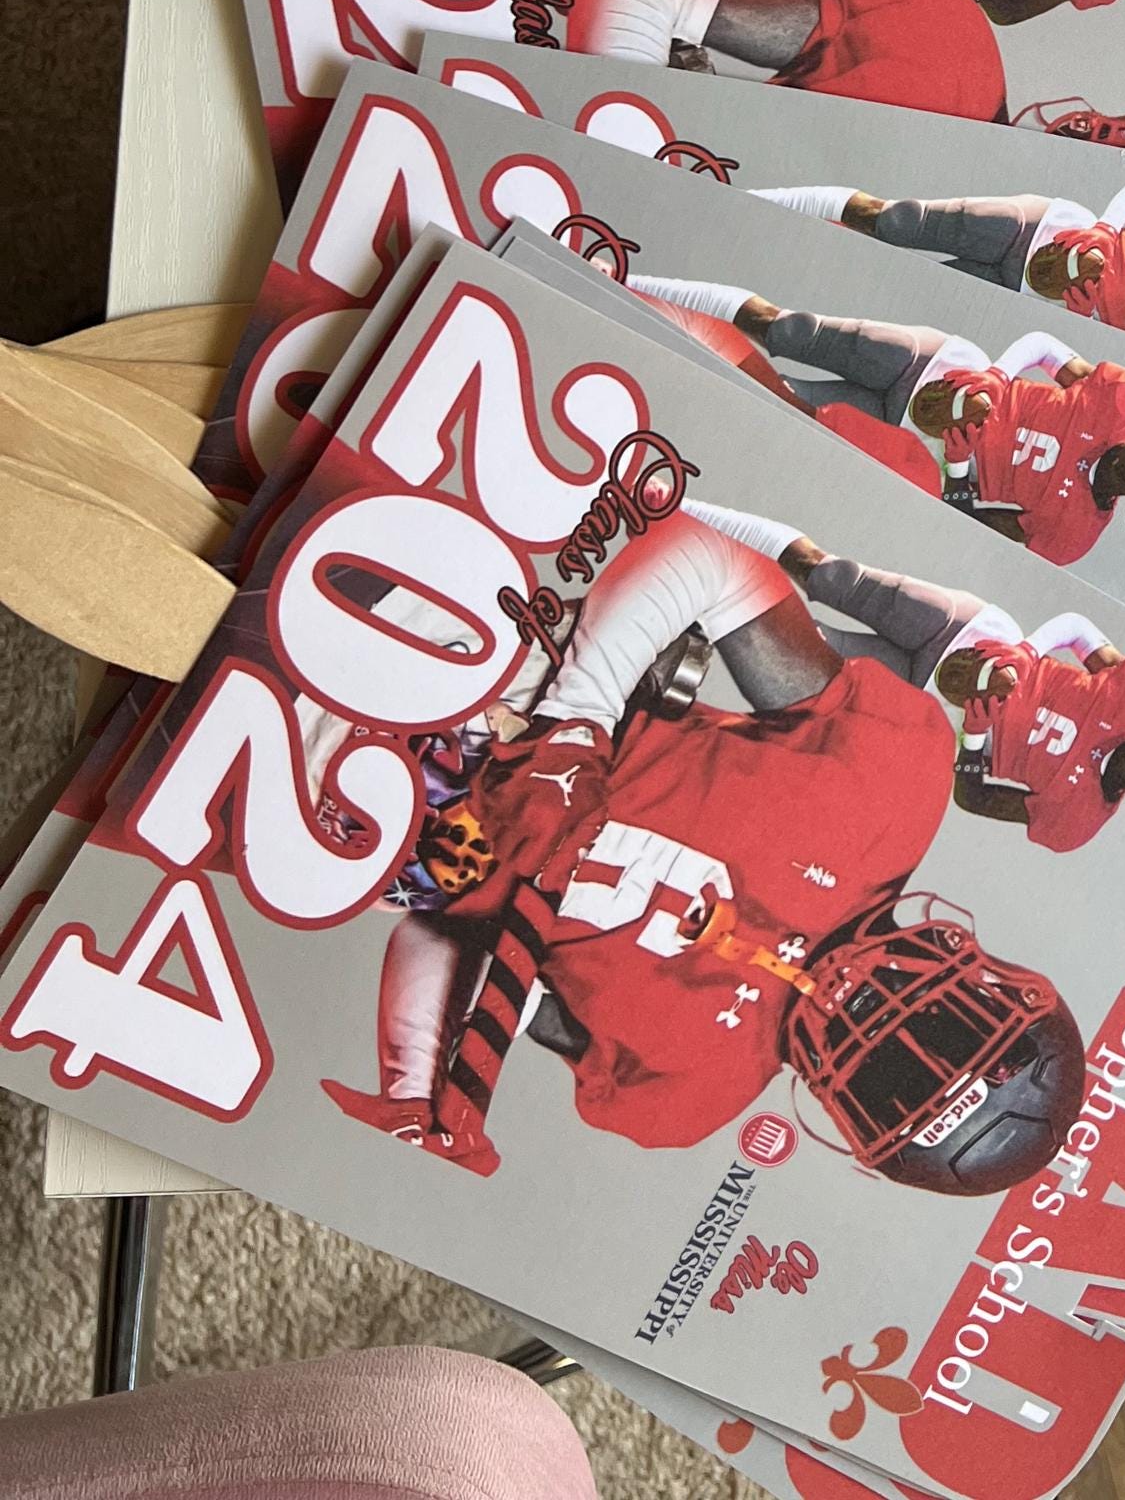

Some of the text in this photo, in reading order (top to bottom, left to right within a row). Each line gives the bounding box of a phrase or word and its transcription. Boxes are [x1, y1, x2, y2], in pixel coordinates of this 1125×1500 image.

[497, 429, 702, 666] Class of
[0, 281, 650, 1122] 2024
[634, 1160, 756, 1346] MISSISSIPPI
[674, 1199, 750, 1329] UNIVERSITY
[709, 1234, 783, 1314] Miss
[771, 1239, 820, 1297] Ole
[922, 1224, 1055, 1415] School
